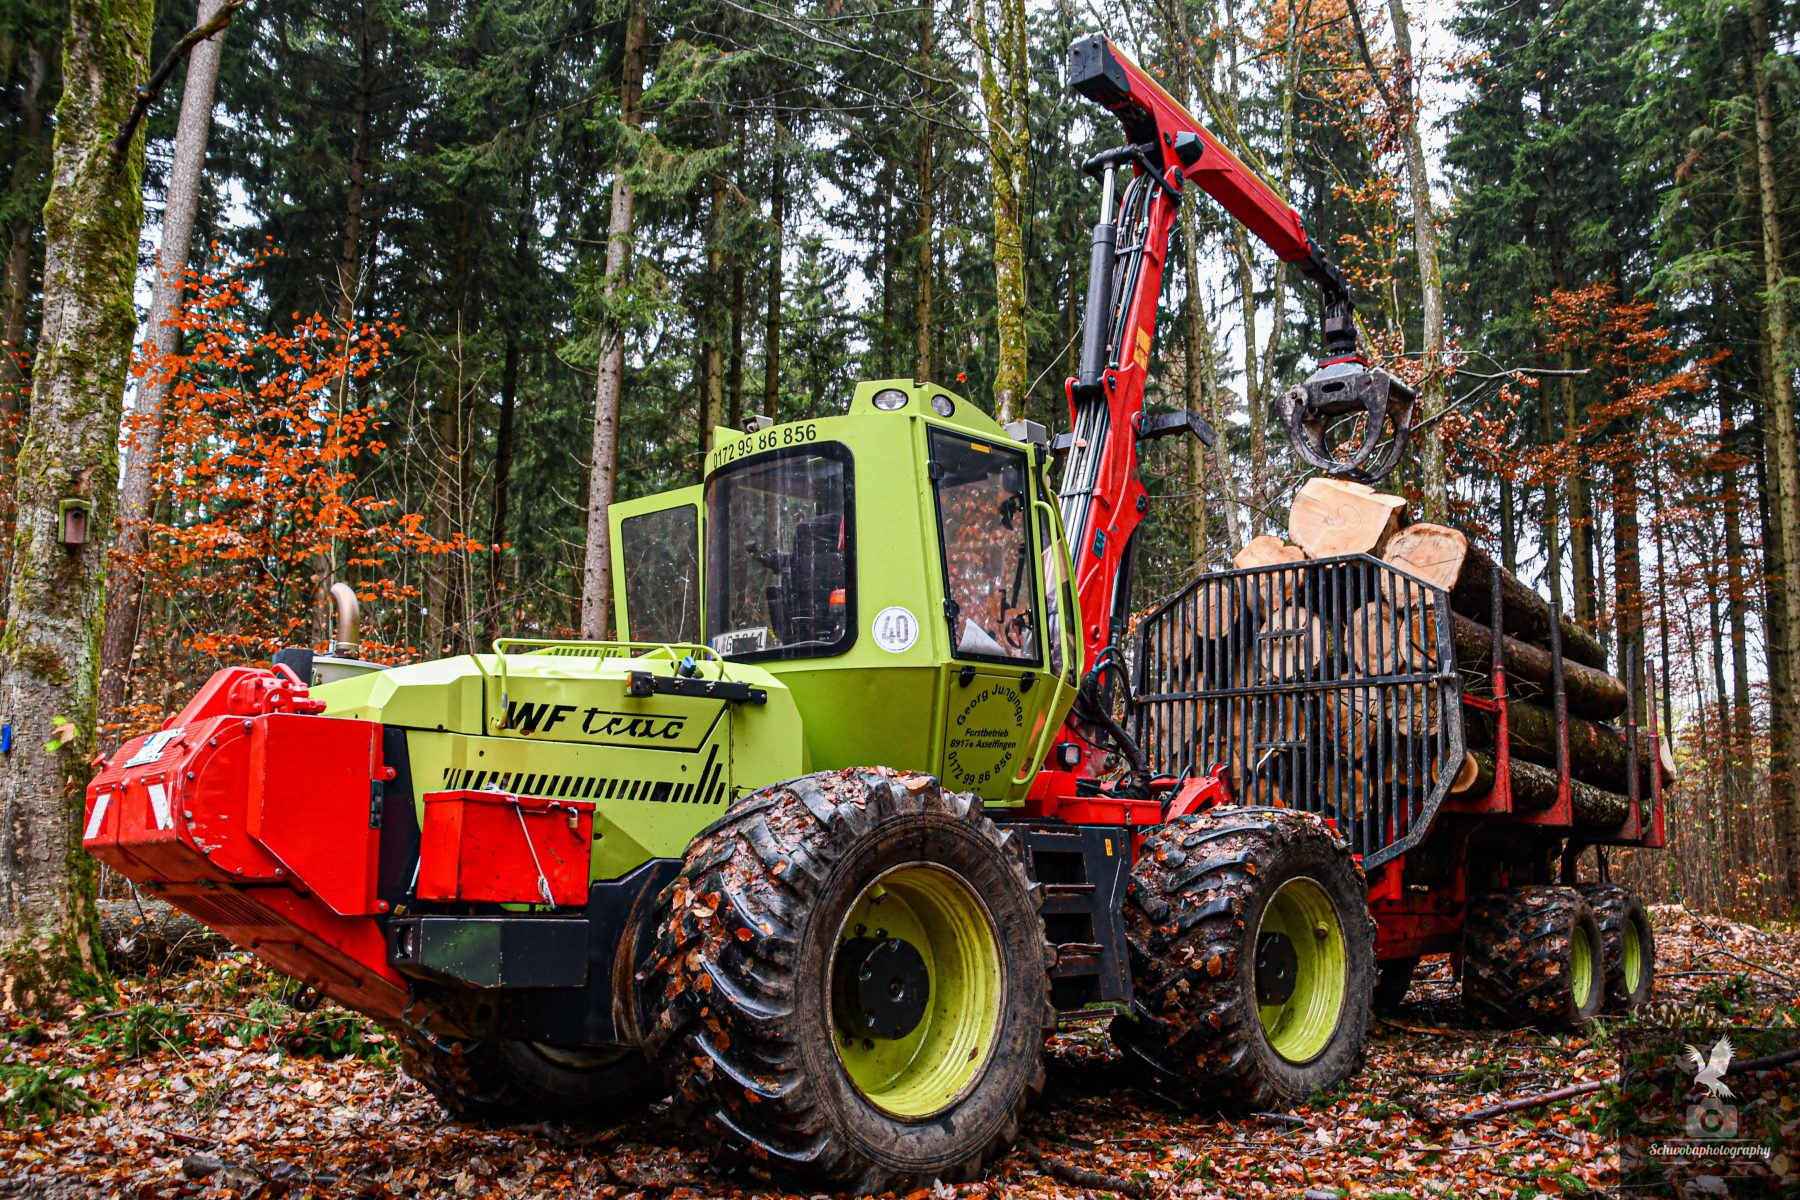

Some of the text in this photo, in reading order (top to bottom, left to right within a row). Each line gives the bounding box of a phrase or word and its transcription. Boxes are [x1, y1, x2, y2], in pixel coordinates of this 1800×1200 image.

[713, 424, 817, 469] 0172 99 86 856
[881, 614, 909, 644] 40
[507, 701, 577, 732] WF
[957, 683, 1023, 727] Georg Junginger
[965, 728, 1008, 737] Forstbetrieb
[975, 740, 1016, 750] Asselfingen
[948, 752, 1012, 785] 0172 99 86 856
